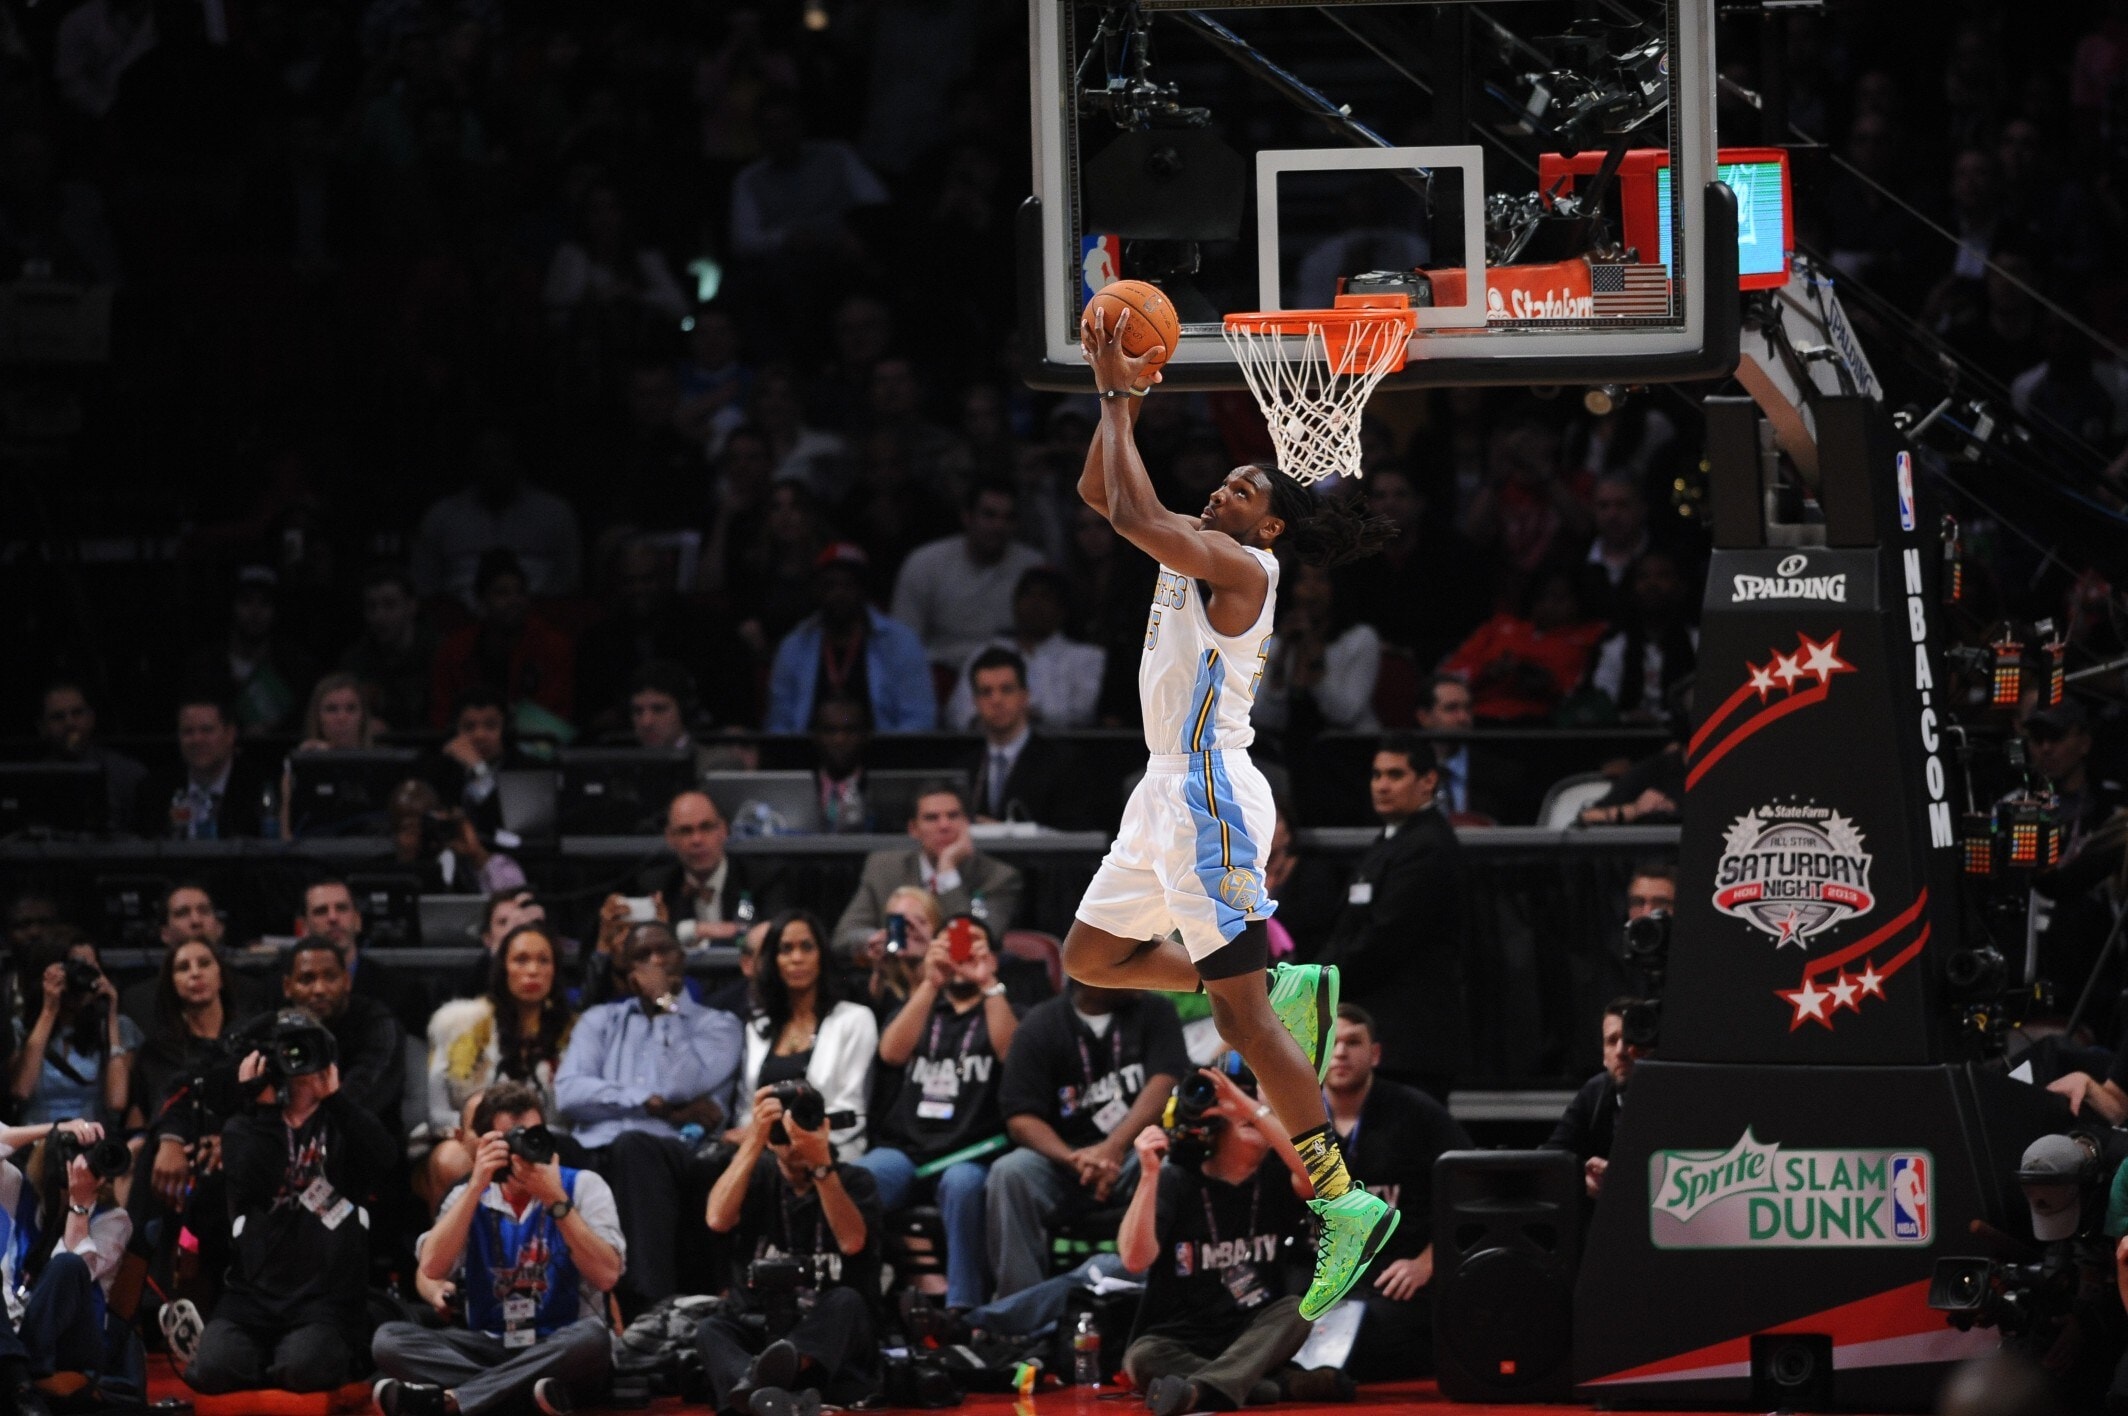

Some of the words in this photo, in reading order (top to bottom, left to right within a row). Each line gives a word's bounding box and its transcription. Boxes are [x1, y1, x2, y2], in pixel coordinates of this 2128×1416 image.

[1731, 573, 1847, 603] SPALDING
[1720, 851, 1867, 886] SATURDAY
[1763, 879, 1824, 898] NIGHT
[1667, 1147, 1765, 1210] Sprite
[1786, 1157, 1886, 1191] SLAM
[1749, 1196, 1886, 1240] DUNK
